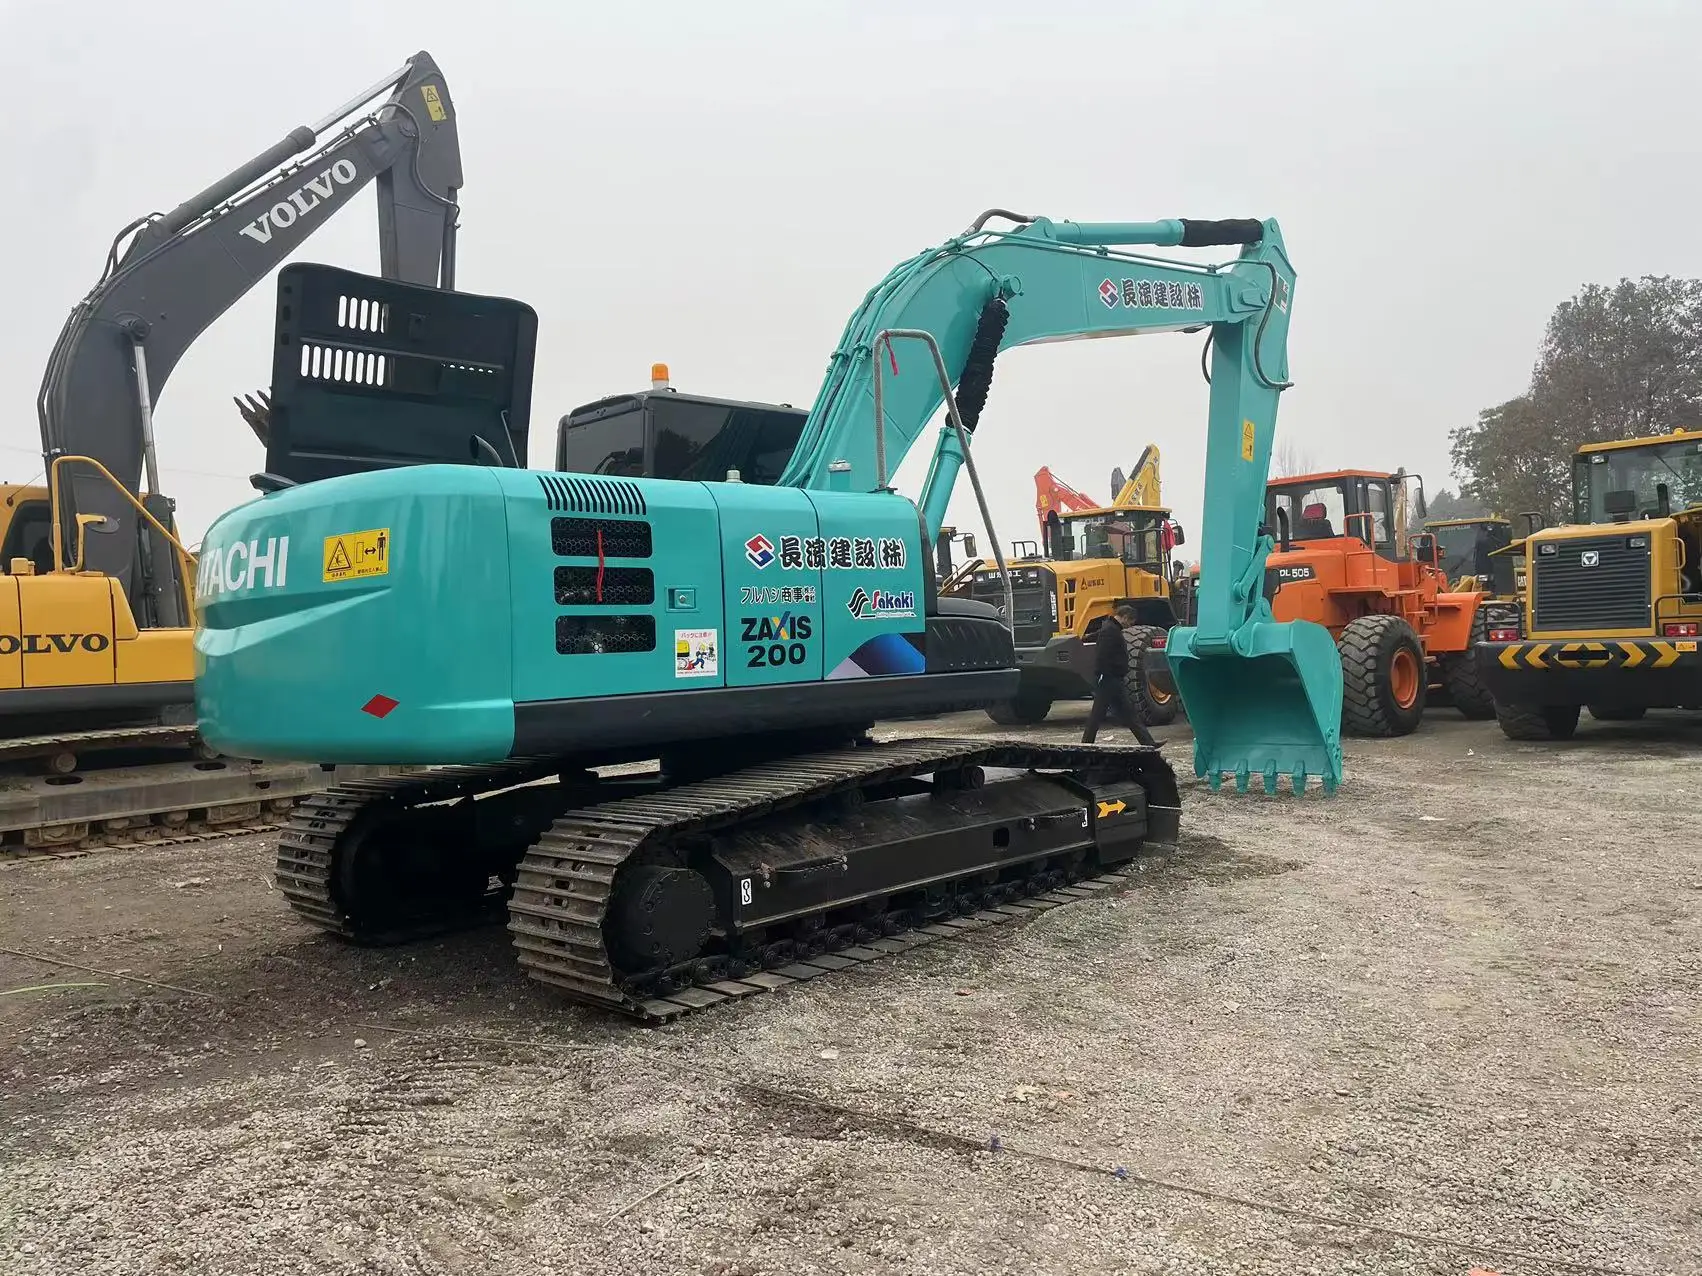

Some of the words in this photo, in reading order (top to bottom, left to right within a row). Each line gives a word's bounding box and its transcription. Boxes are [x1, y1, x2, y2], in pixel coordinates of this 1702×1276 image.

[239, 159, 357, 244] VOLVO
[1291, 567, 1310, 578] 505
[871, 590, 914, 611] Sakaki
[740, 610, 812, 641] ZAXIS
[747, 643, 806, 668] 200
